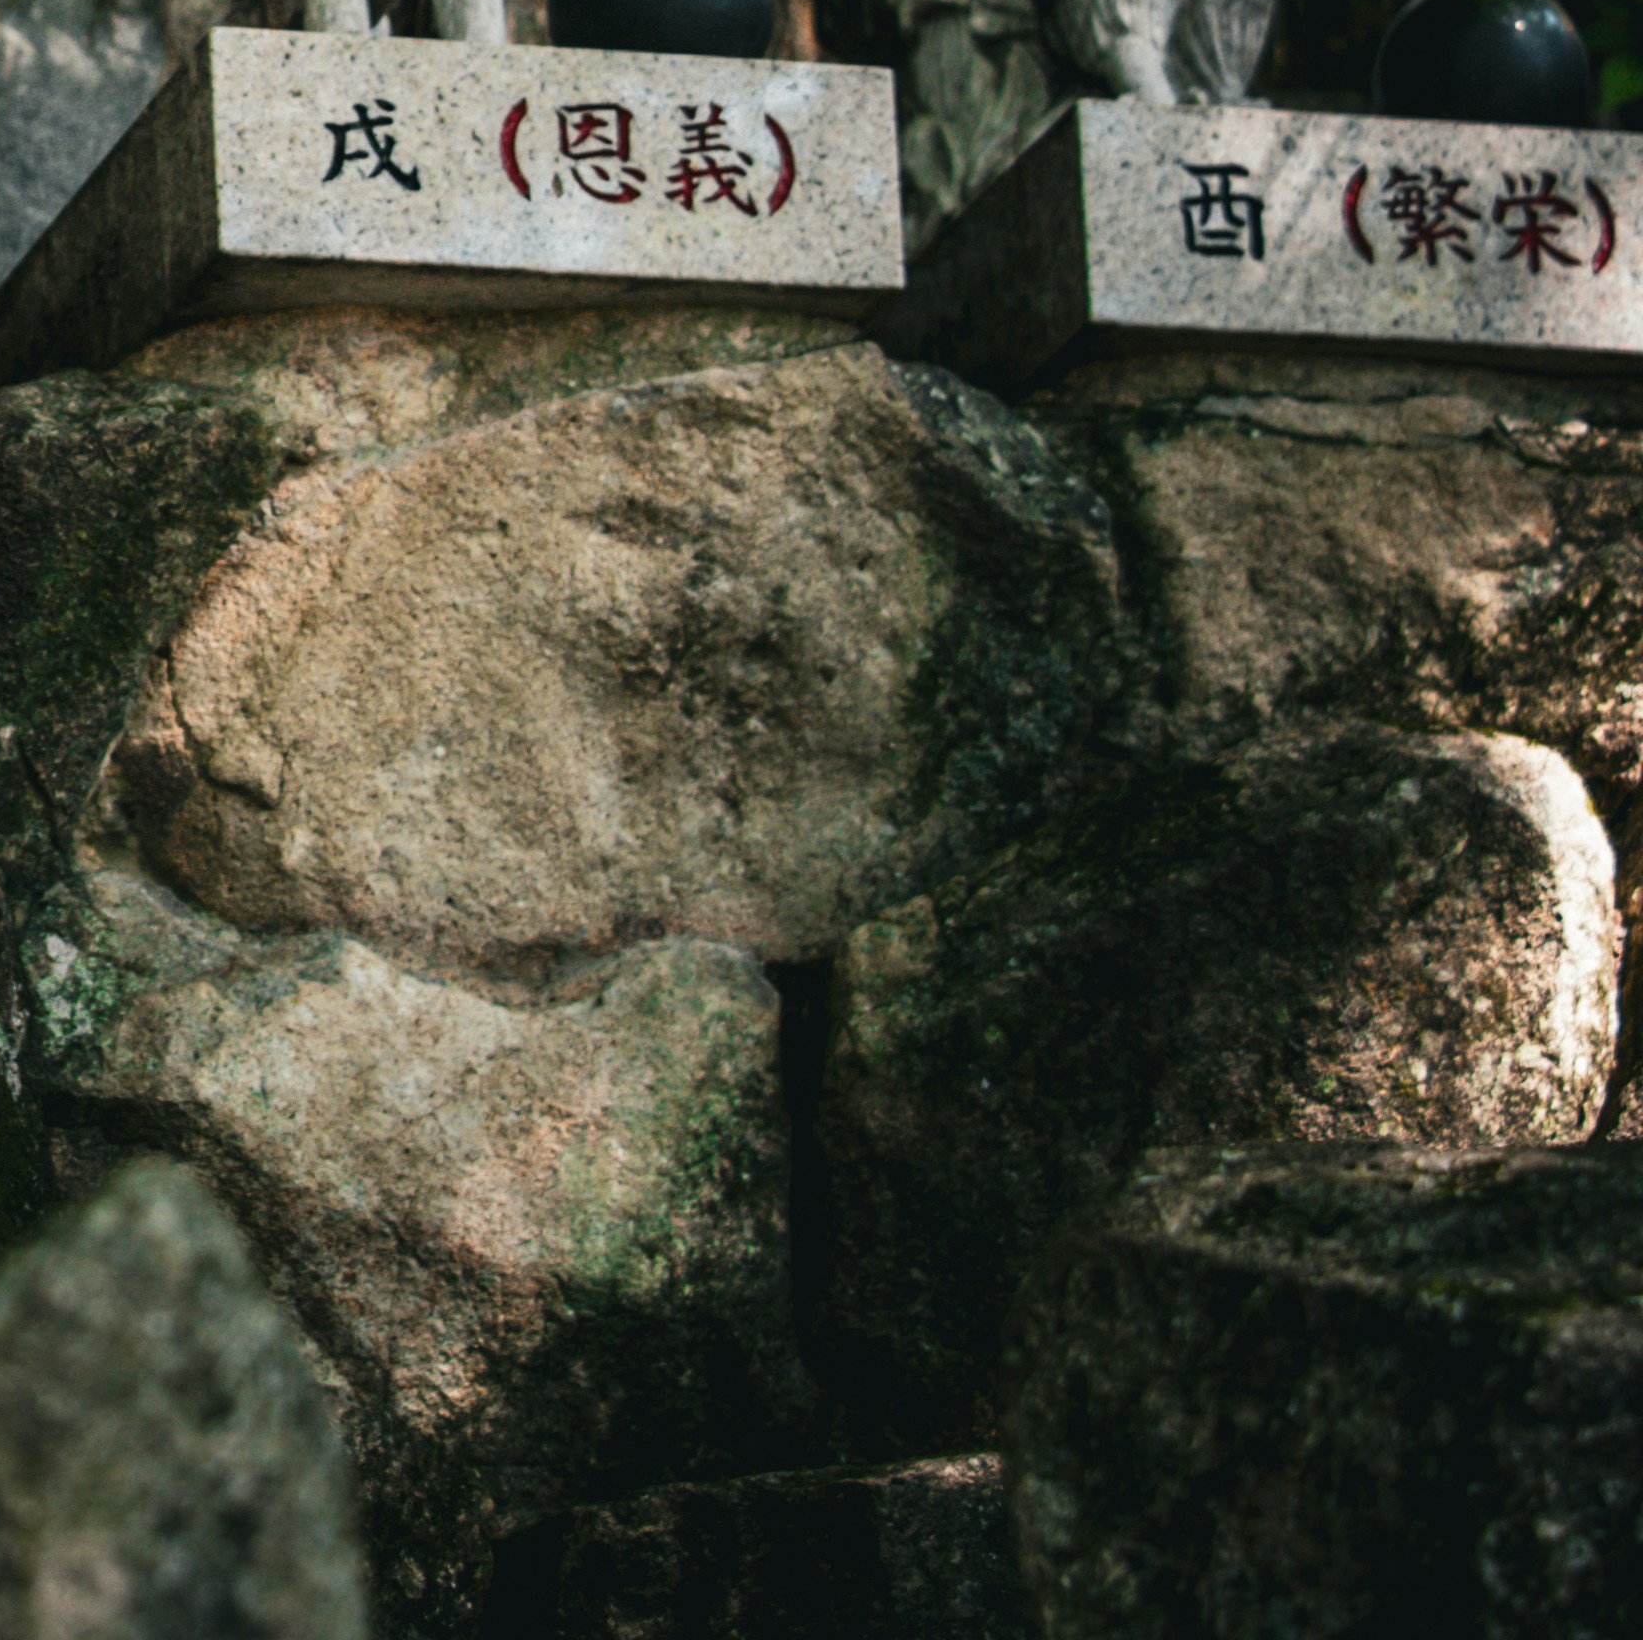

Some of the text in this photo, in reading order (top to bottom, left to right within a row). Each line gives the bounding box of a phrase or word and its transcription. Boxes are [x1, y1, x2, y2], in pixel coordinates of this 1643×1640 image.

[322, 98, 797, 217] 戌 (恩義)
[1180, 163, 1615, 275] 酉 (繁栄)
